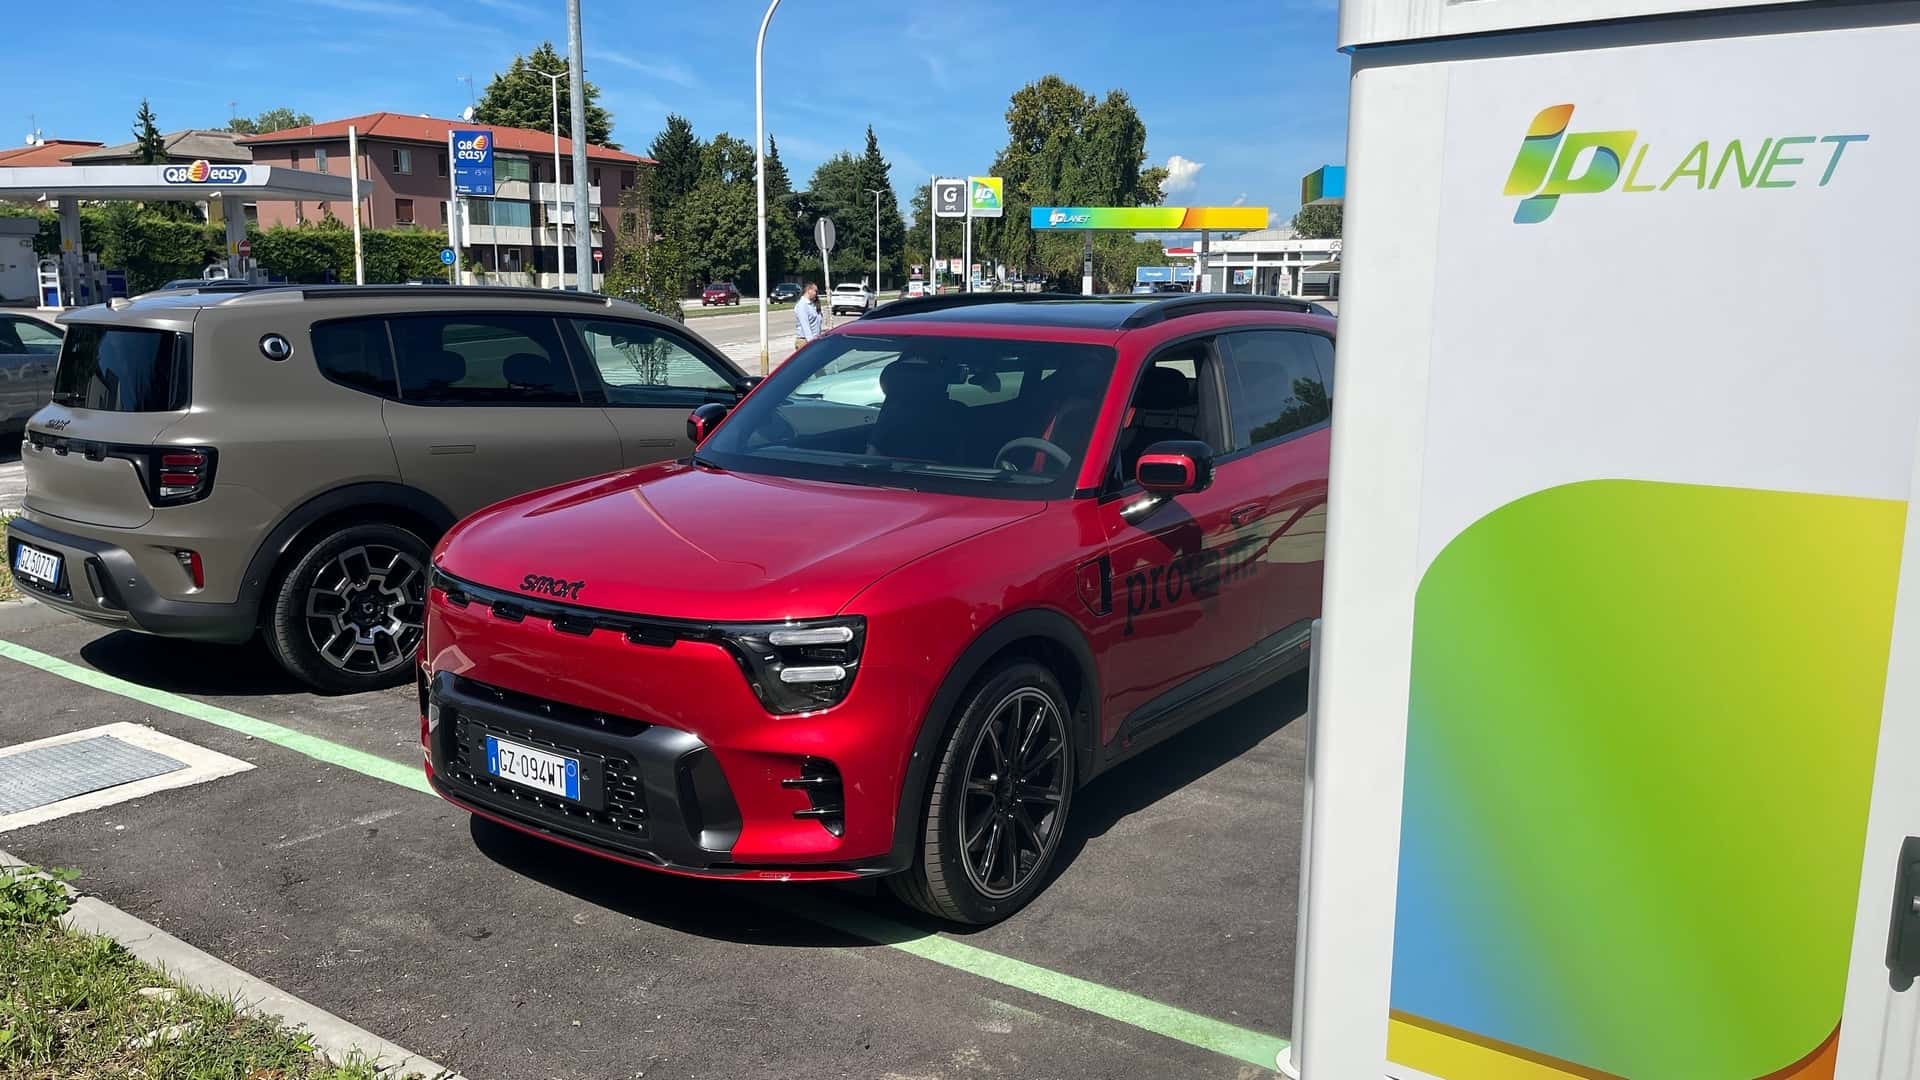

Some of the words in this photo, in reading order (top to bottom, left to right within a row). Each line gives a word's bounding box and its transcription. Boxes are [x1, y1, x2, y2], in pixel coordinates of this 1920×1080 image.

[458, 140, 472, 150] Q8
[458, 150, 487, 163] easy
[166, 168, 187, 182] Q8
[210, 168, 242, 184] easy
[944, 187, 957, 203] G
[520, 574, 585, 600] smart
[499, 748, 516, 775] GZ
[520, 754, 565, 790] 094WT
